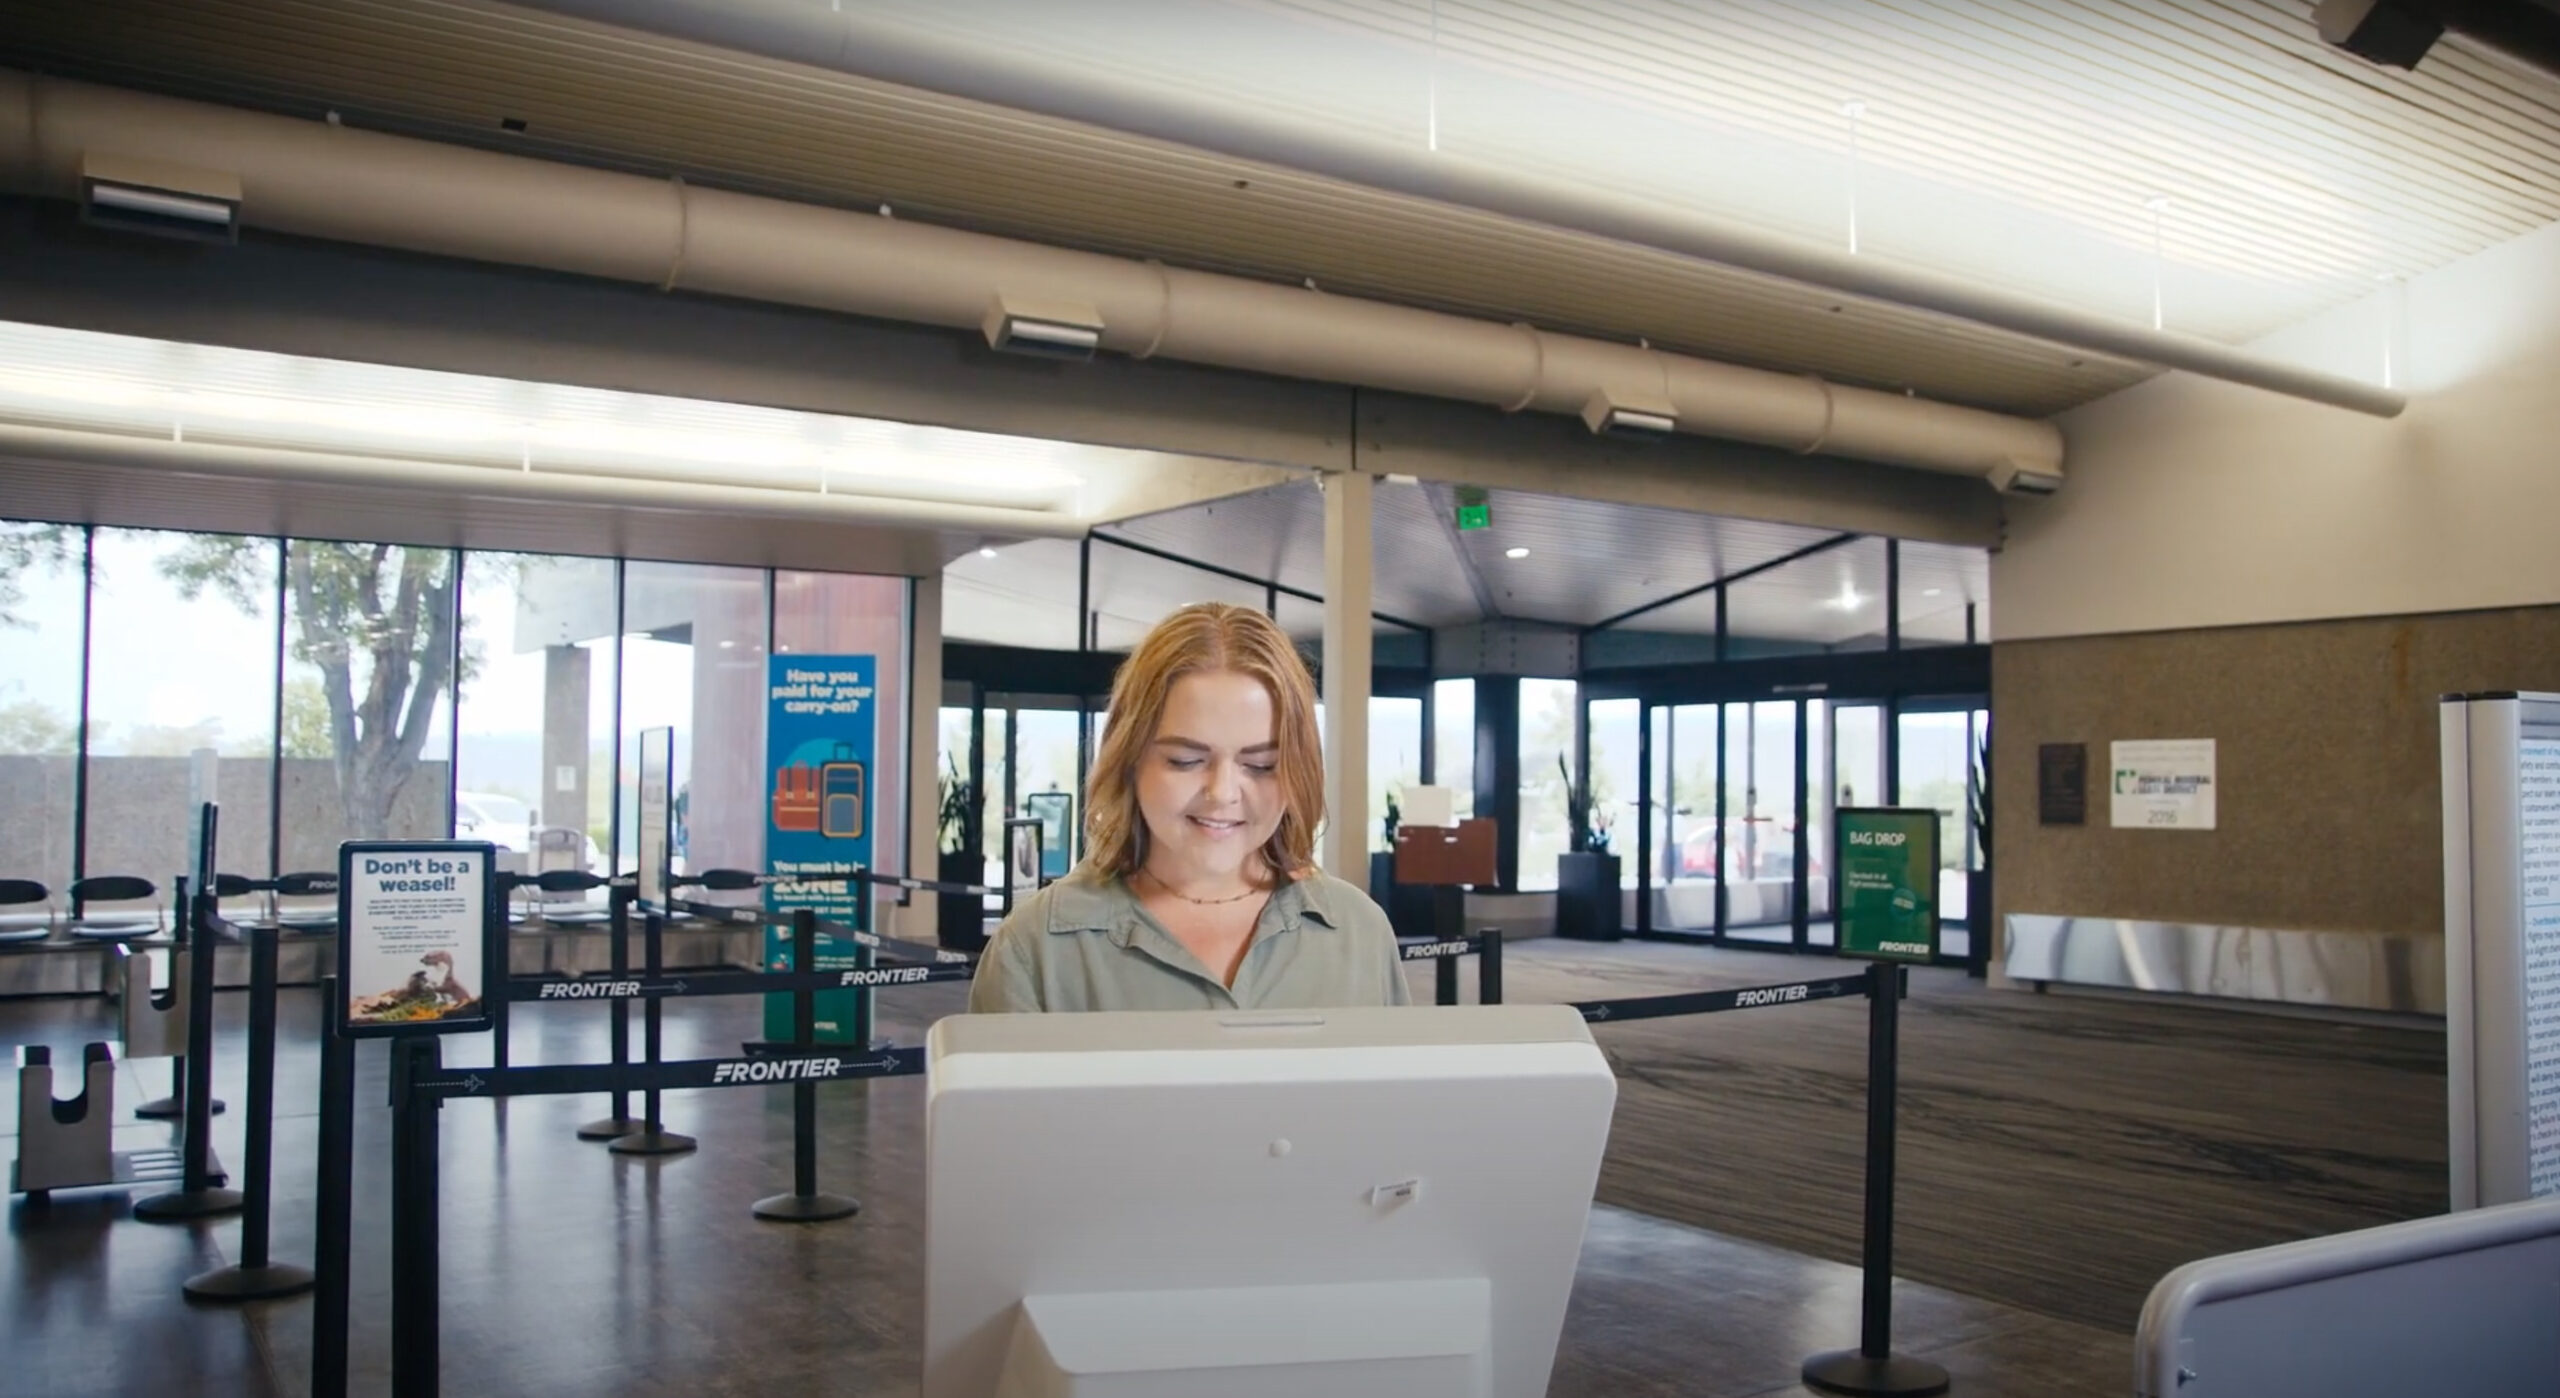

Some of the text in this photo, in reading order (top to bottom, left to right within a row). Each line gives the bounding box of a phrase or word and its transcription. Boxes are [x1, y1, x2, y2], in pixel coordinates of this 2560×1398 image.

[786, 669, 858, 685] Have you
[771, 684, 873, 700] paid for your
[784, 699, 860, 715] carry-on?
[1850, 831, 1906, 845] BAG DROP
[365, 858, 470, 875] Don't be a
[773, 860, 797, 873] You
[801, 861, 832, 873] must
[833, 861, 851, 873] be
[380, 876, 456, 893] weasel!
[773, 878, 848, 894] ZONE
[1405, 941, 1469, 958] FRONTIER
[1879, 941, 1930, 954] FRONTIER
[840, 967, 929, 986] FRONTIER
[540, 981, 641, 998] FRONTIER
[1735, 985, 1808, 1007] FRONTIER
[713, 1057, 841, 1083] FRONTIER
